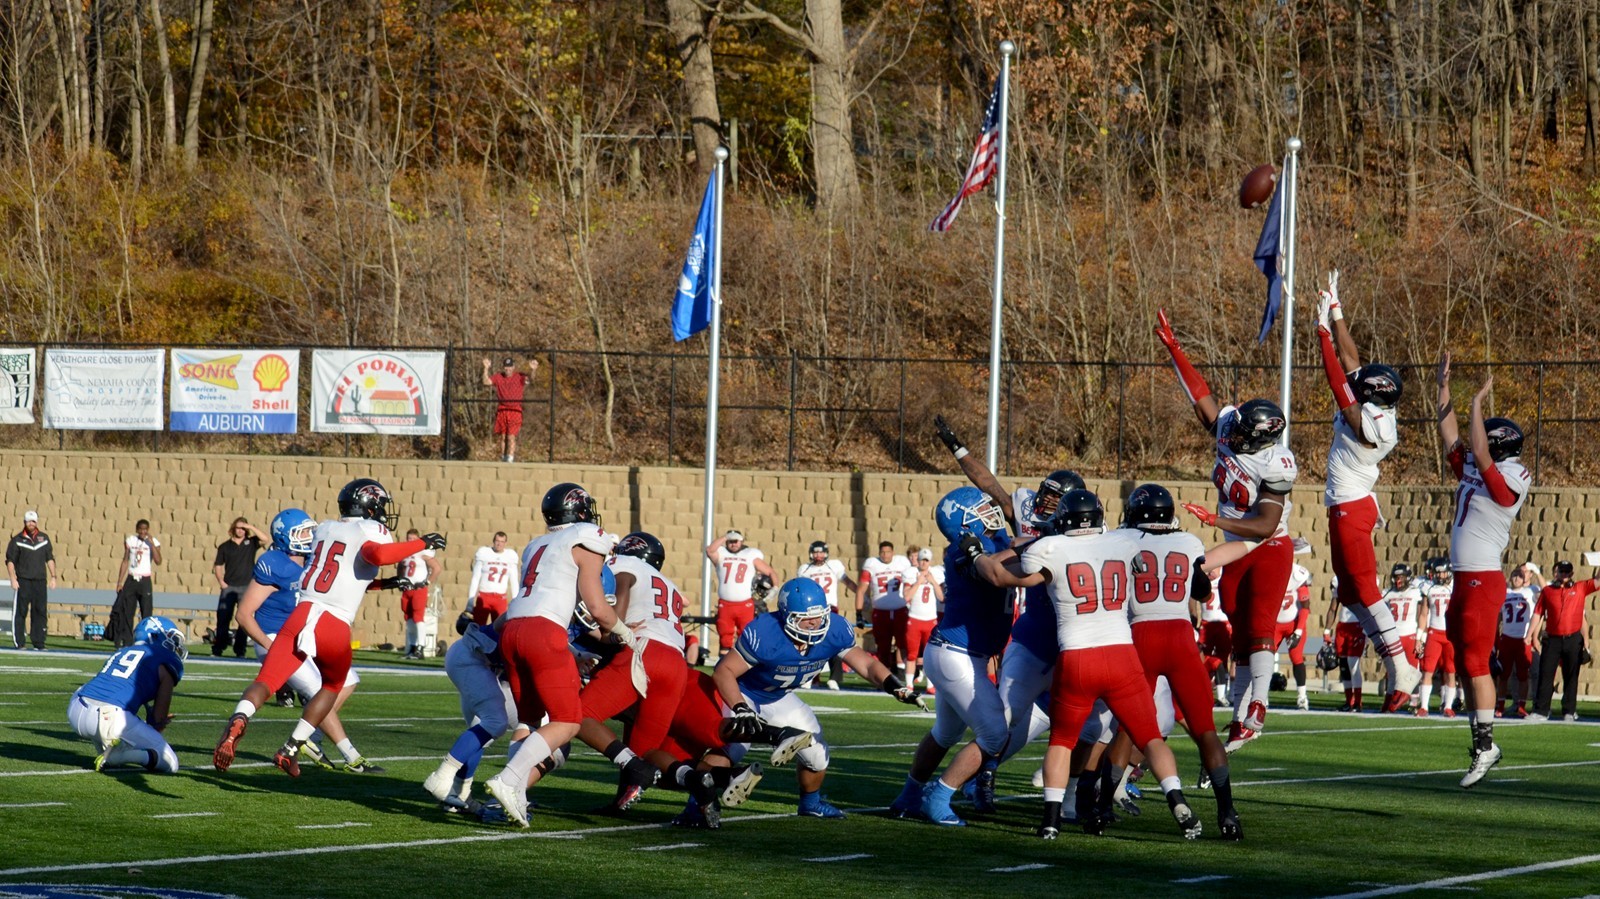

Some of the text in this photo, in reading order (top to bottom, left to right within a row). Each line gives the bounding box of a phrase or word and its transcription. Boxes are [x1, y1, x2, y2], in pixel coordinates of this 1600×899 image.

[51, 355, 157, 365] HEALTHCARE CLOSE TO HOME
[181, 363, 238, 379] SONIC
[87, 387, 158, 395] HOSPITAL
[126, 378, 158, 387] COUNTY
[185, 385, 217, 393] America's
[252, 399, 289, 410] Shell
[198, 413, 265, 431] AUBURN
[301, 540, 347, 594] 16
[488, 567, 508, 583] 21
[520, 544, 549, 598] 4
[723, 562, 748, 584] 78
[1131, 549, 1189, 604] 88
[922, 586, 931, 603] 8
[1066, 559, 1127, 615] 90
[651, 575, 684, 635] 39
[101, 650, 145, 679] 19
